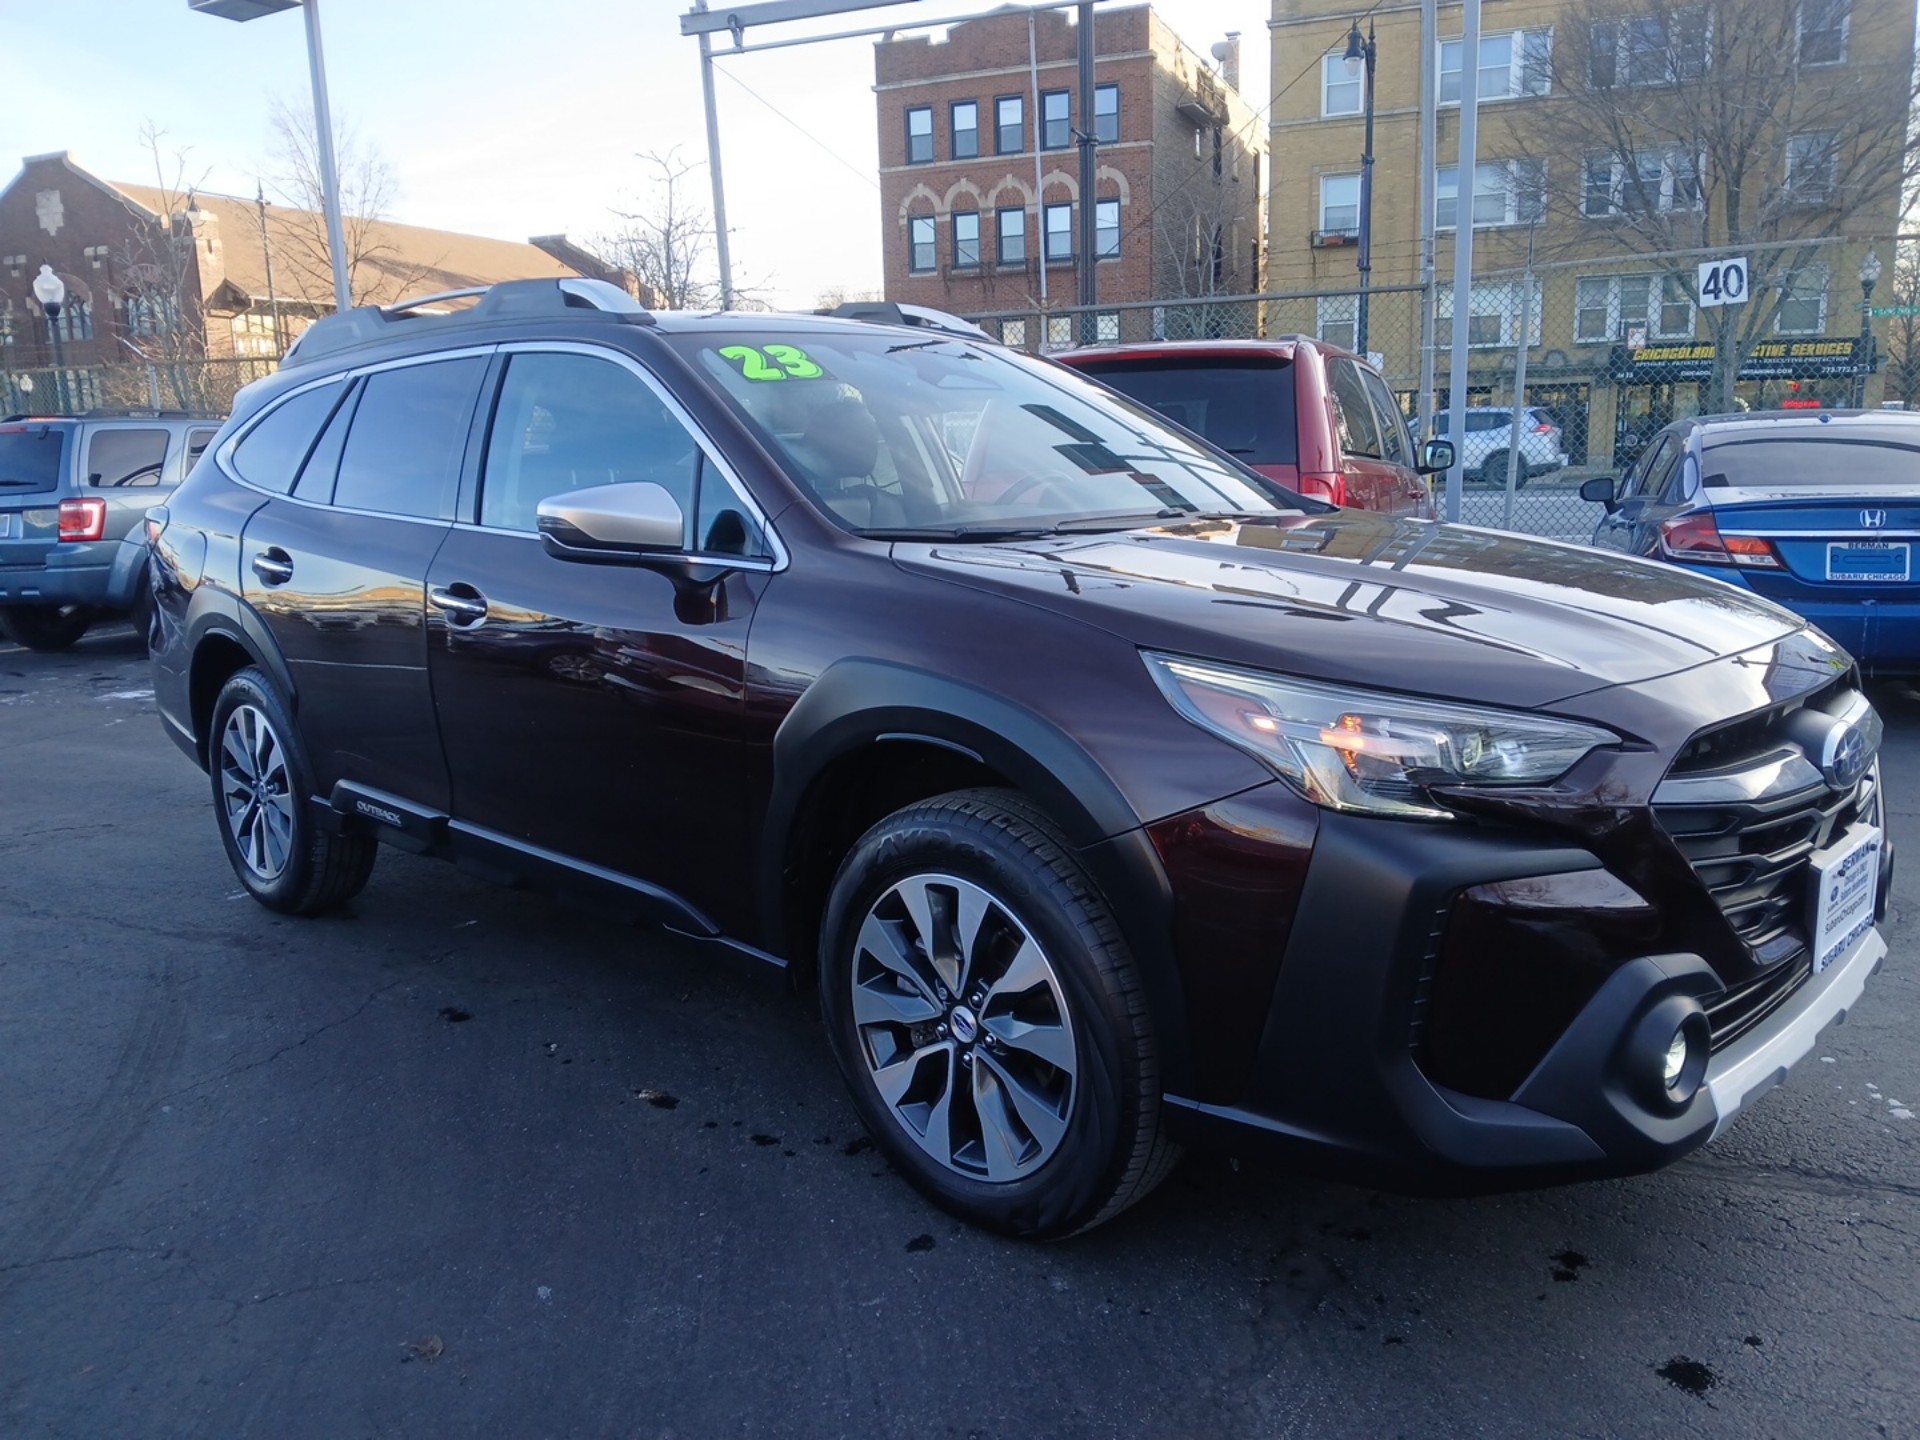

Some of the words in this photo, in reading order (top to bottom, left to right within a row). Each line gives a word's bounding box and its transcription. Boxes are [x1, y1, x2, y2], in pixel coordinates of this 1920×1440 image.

[1702, 264, 1744, 301] 40
[718, 343, 824, 382] 23
[1790, 342, 1854, 356] SERVICES
[356, 800, 401, 825] OUTBACK
[1842, 840, 1871, 870] BERMAN
[1847, 913, 1874, 947] CHICAGO
